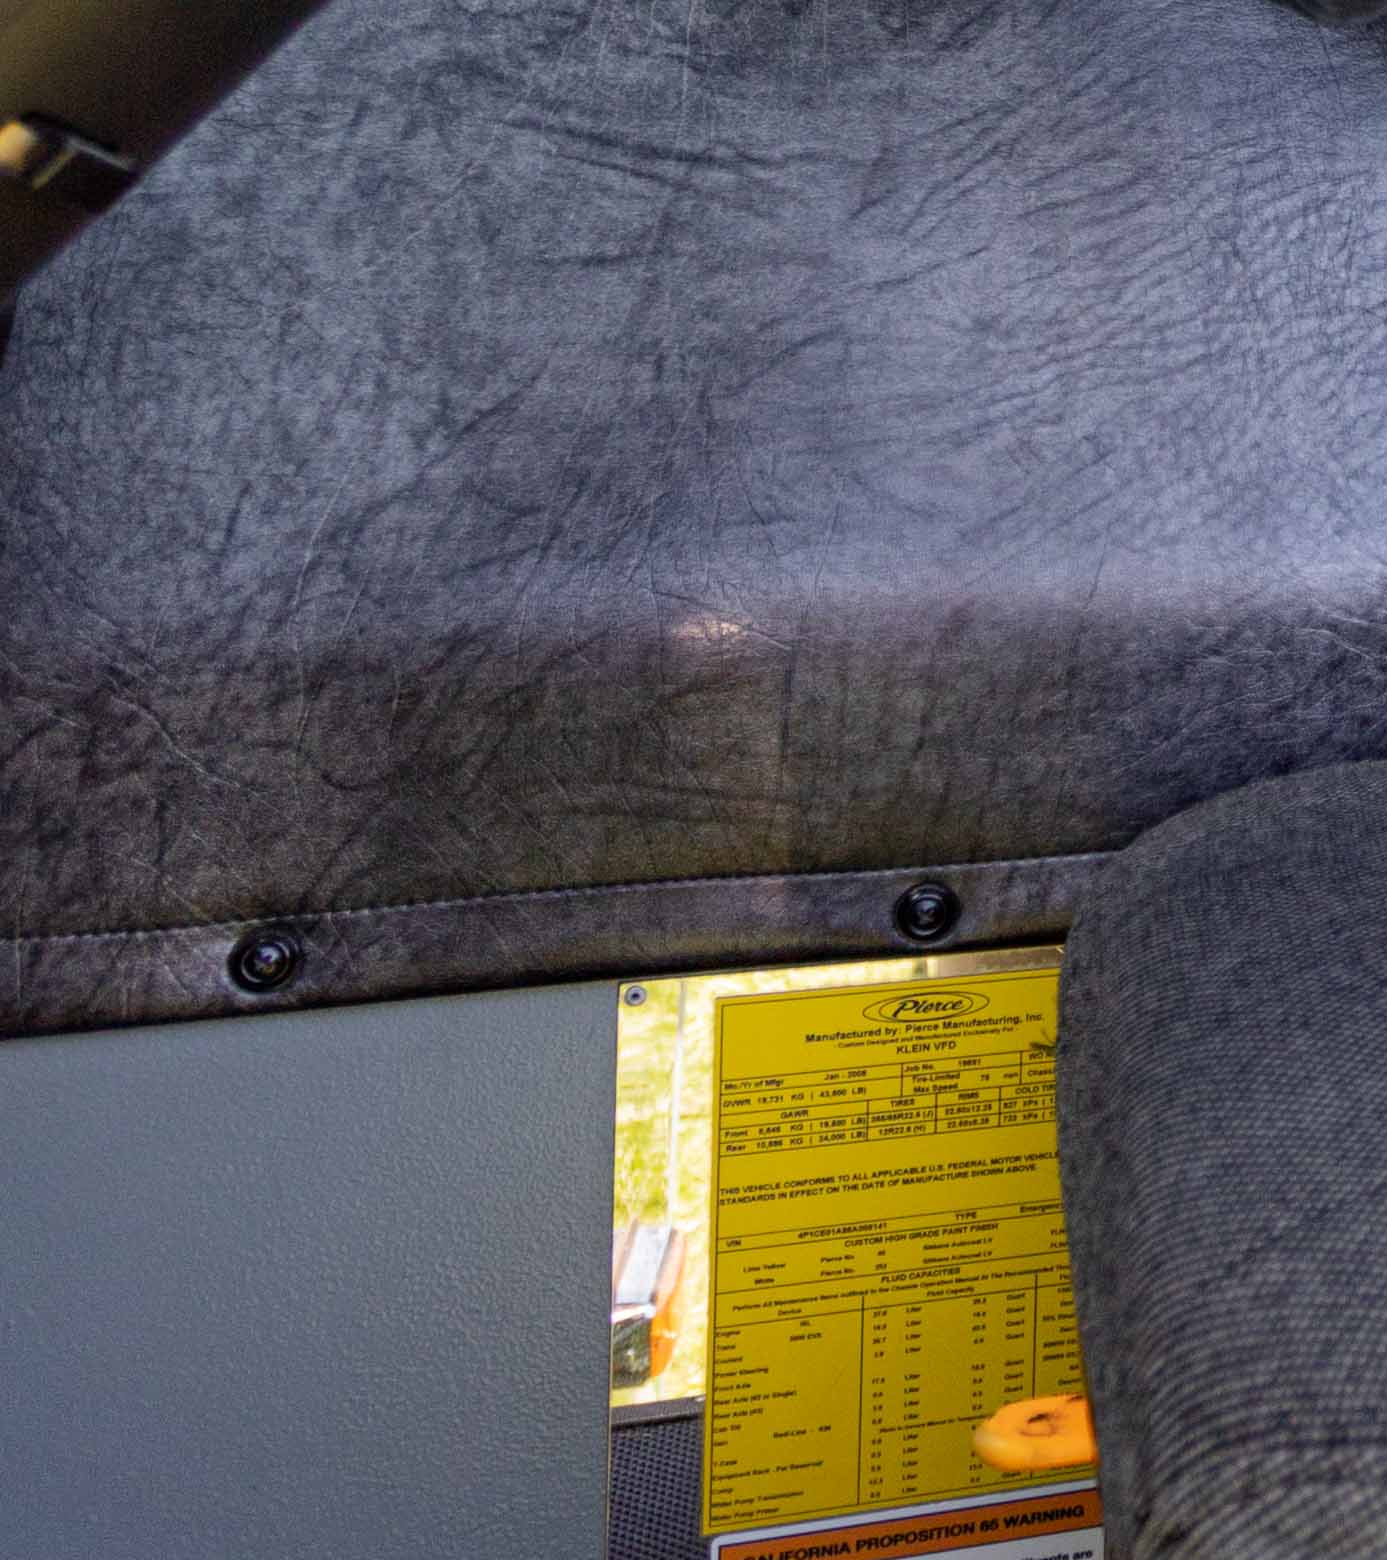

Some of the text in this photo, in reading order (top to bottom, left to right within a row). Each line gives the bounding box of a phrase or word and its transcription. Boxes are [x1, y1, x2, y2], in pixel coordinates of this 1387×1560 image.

[893, 999, 964, 1021] Pierce
[805, 1029, 882, 1043] Manufactured
[905, 1023, 939, 1034] Pierce
[896, 1040, 957, 1055] KLEIN VFD
[903, 1064, 920, 1073] Job
[723, 1098, 751, 1108] GVWR
[890, 1098, 915, 1108] TIRES
[781, 1109, 809, 1119] GAWR
[725, 1129, 748, 1138] Front
[726, 1143, 746, 1152] Rear
[720, 1187, 740, 1196] THIS
[743, 1183, 780, 1193] VEHICLE
[784, 1177, 835, 1188] CONFORMS
[838, 1174, 850, 1182] TO
[852, 1173, 868, 1181] ALL
[872, 1166, 925, 1178] APPLICABLE
[948, 1159, 988, 1170] FEDERAL
[991, 1156, 1022, 1166] MOTOR
[720, 1193, 776, 1206] STANDARDS
[790, 1189, 823, 1199] EFFECT
[826, 1186, 839, 1195] ON
[843, 1184, 859, 1192] THE
[862, 1181, 885, 1191] DATE
[902, 1172, 969, 1185] MANUFACTURE
[972, 1167, 1004, 1179] SHOWN
[955, 1212, 977, 1221] TYPE
[844, 1223, 999, 1248] CUSTOM HIGH GRADE PAINT FINISH
[726, 1239, 742, 1247] VIN
[881, 1266, 961, 1283] FLUID CAPACITIES
[855, 1522, 976, 1552] PROPOSITION
[980, 1518, 999, 1531] 65
[1003, 1505, 1085, 1529] WARNING
[1072, 1550, 1093, 1560] are
